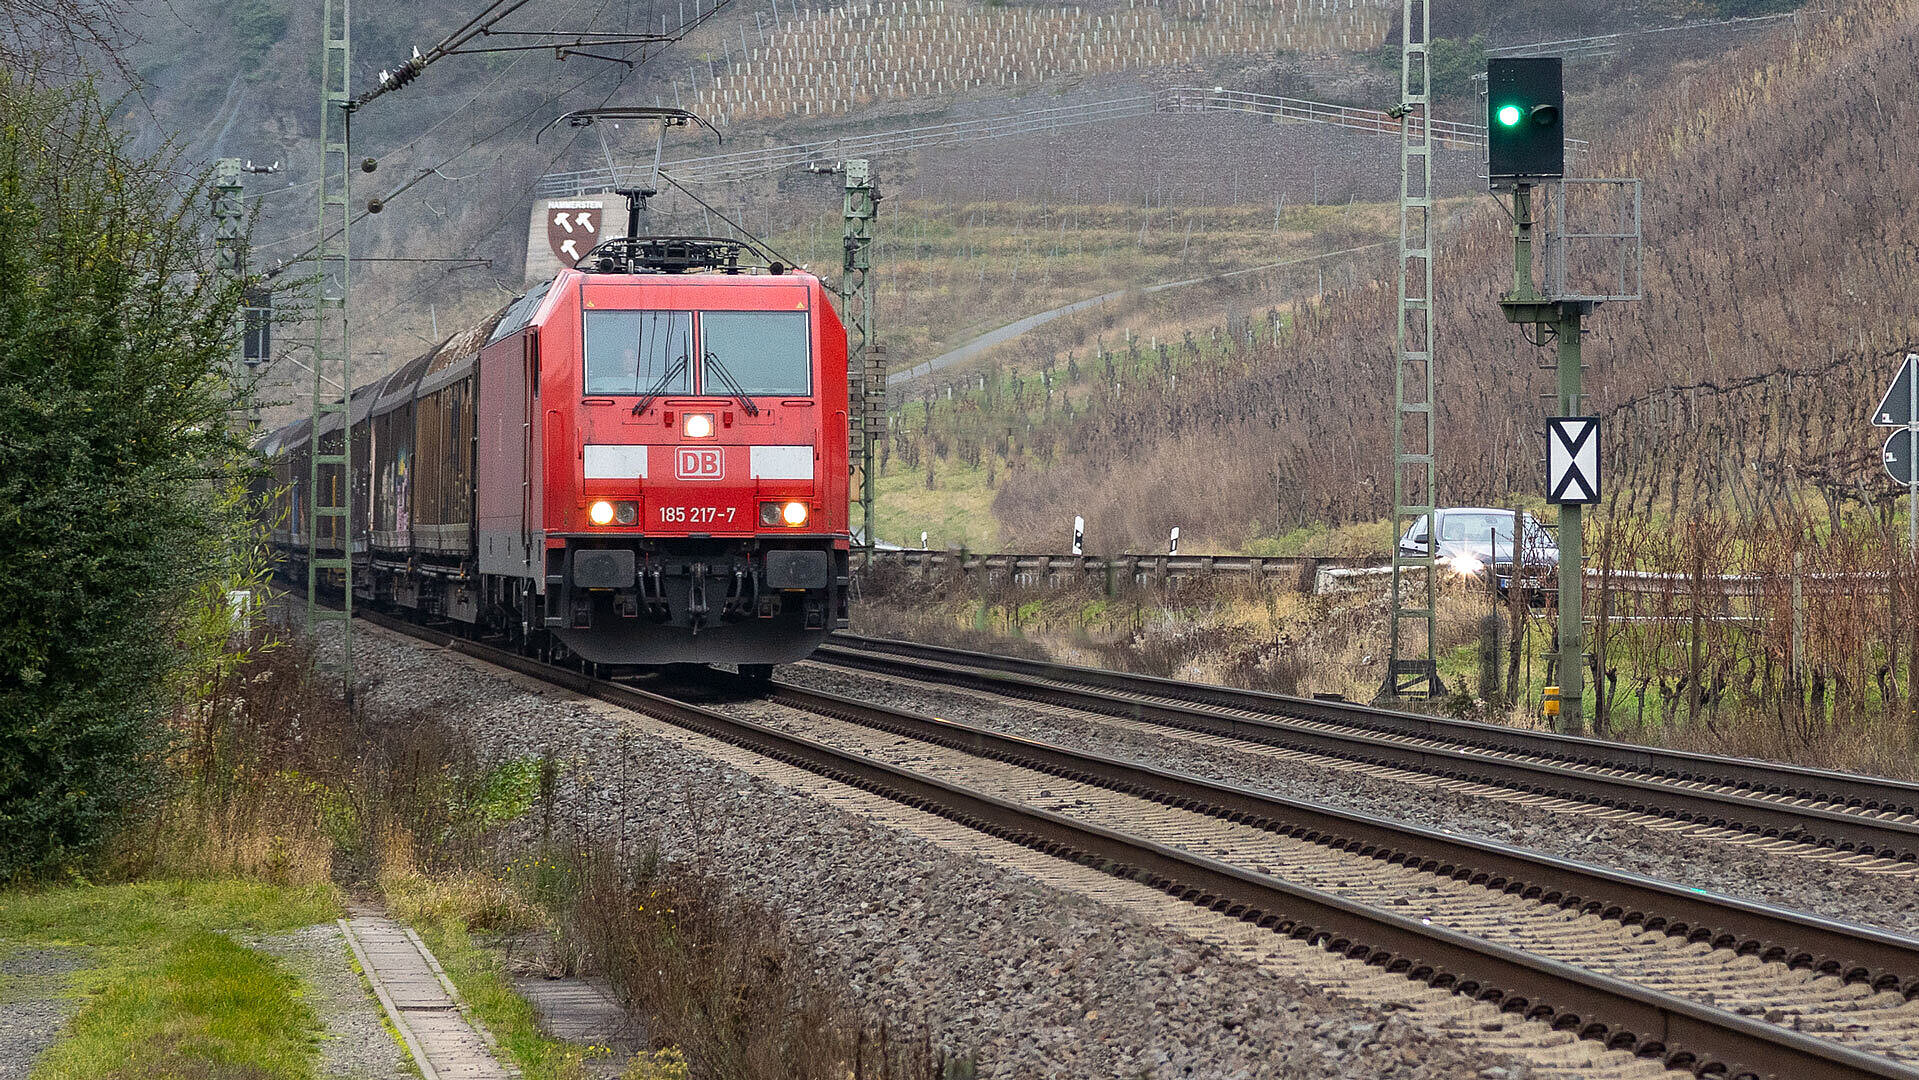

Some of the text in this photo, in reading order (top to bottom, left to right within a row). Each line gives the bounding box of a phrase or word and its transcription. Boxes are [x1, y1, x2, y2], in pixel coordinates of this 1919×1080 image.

[681, 451, 720, 475] DB
[659, 507, 736, 522] 185 217-7
